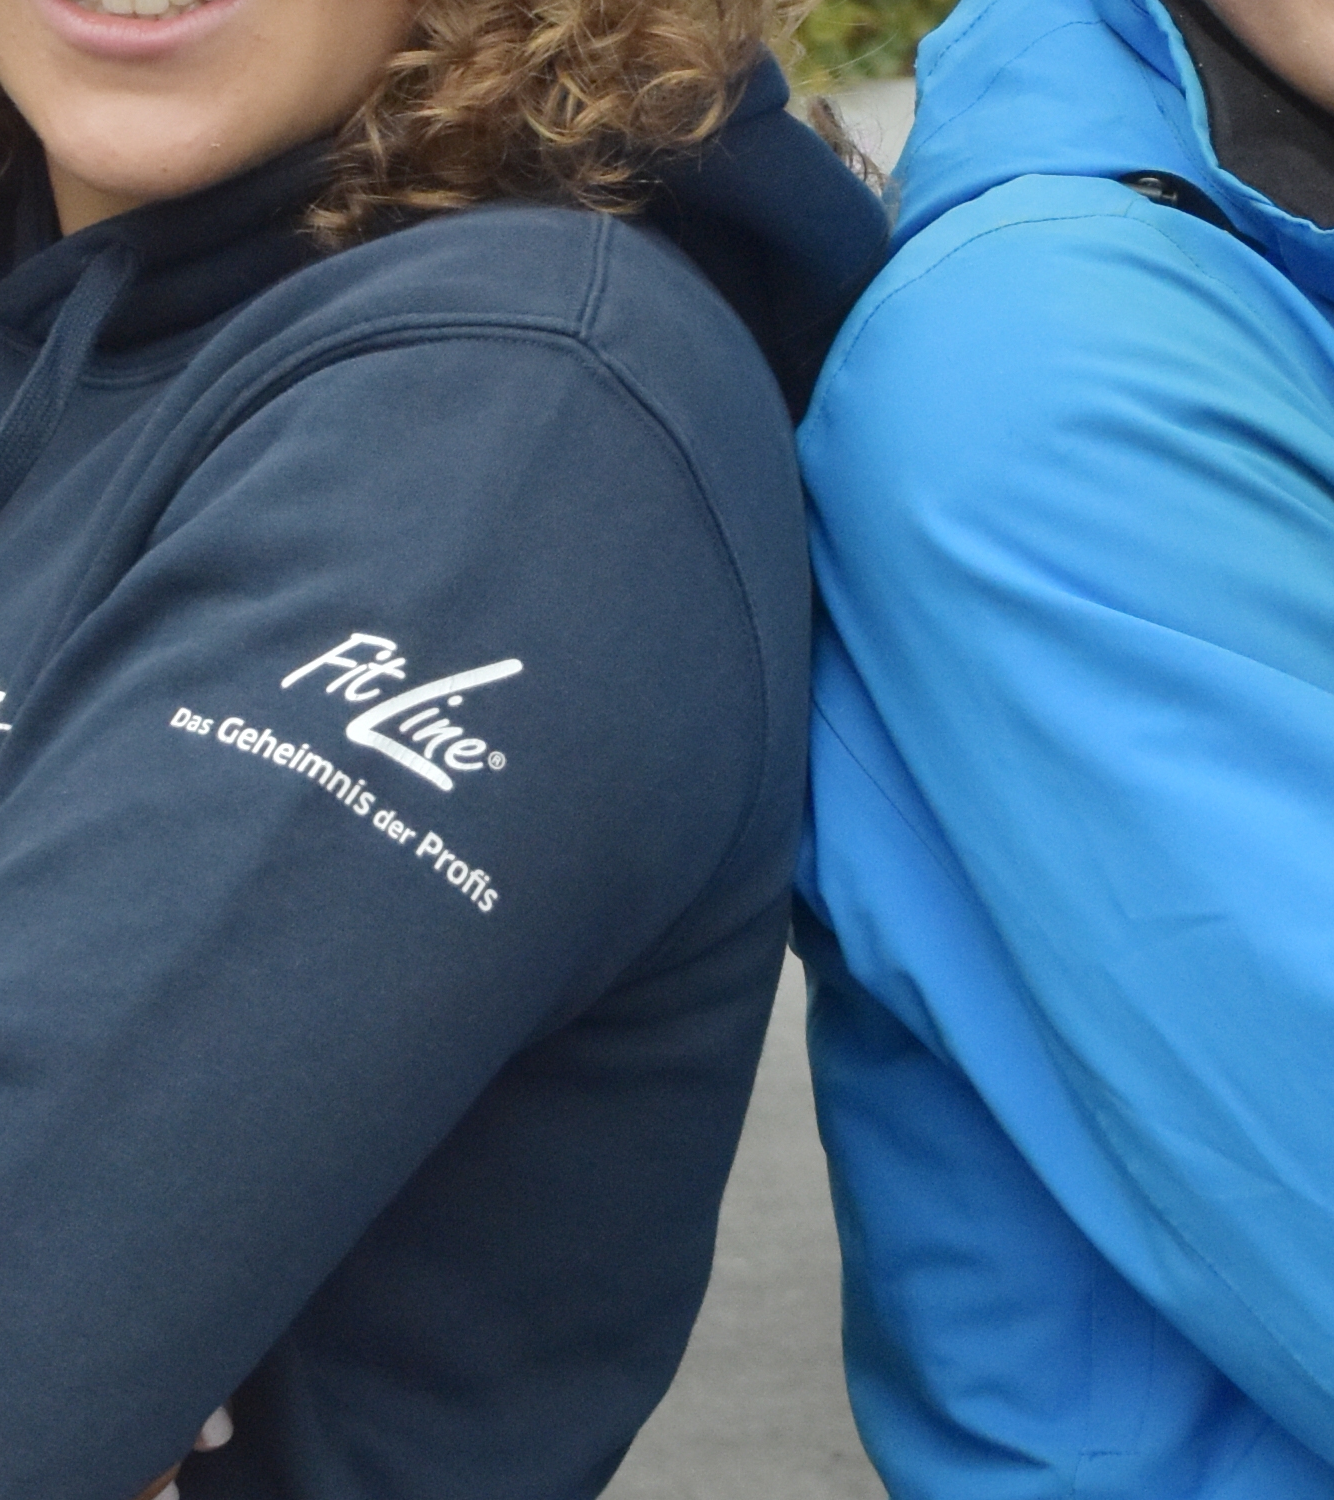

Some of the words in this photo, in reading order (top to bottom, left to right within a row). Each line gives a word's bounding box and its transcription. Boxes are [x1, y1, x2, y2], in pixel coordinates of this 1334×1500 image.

[170, 707, 214, 736] Das
[217, 716, 376, 816] Geheimnis
[373, 810, 417, 846] der
[415, 831, 500, 913] Profis
